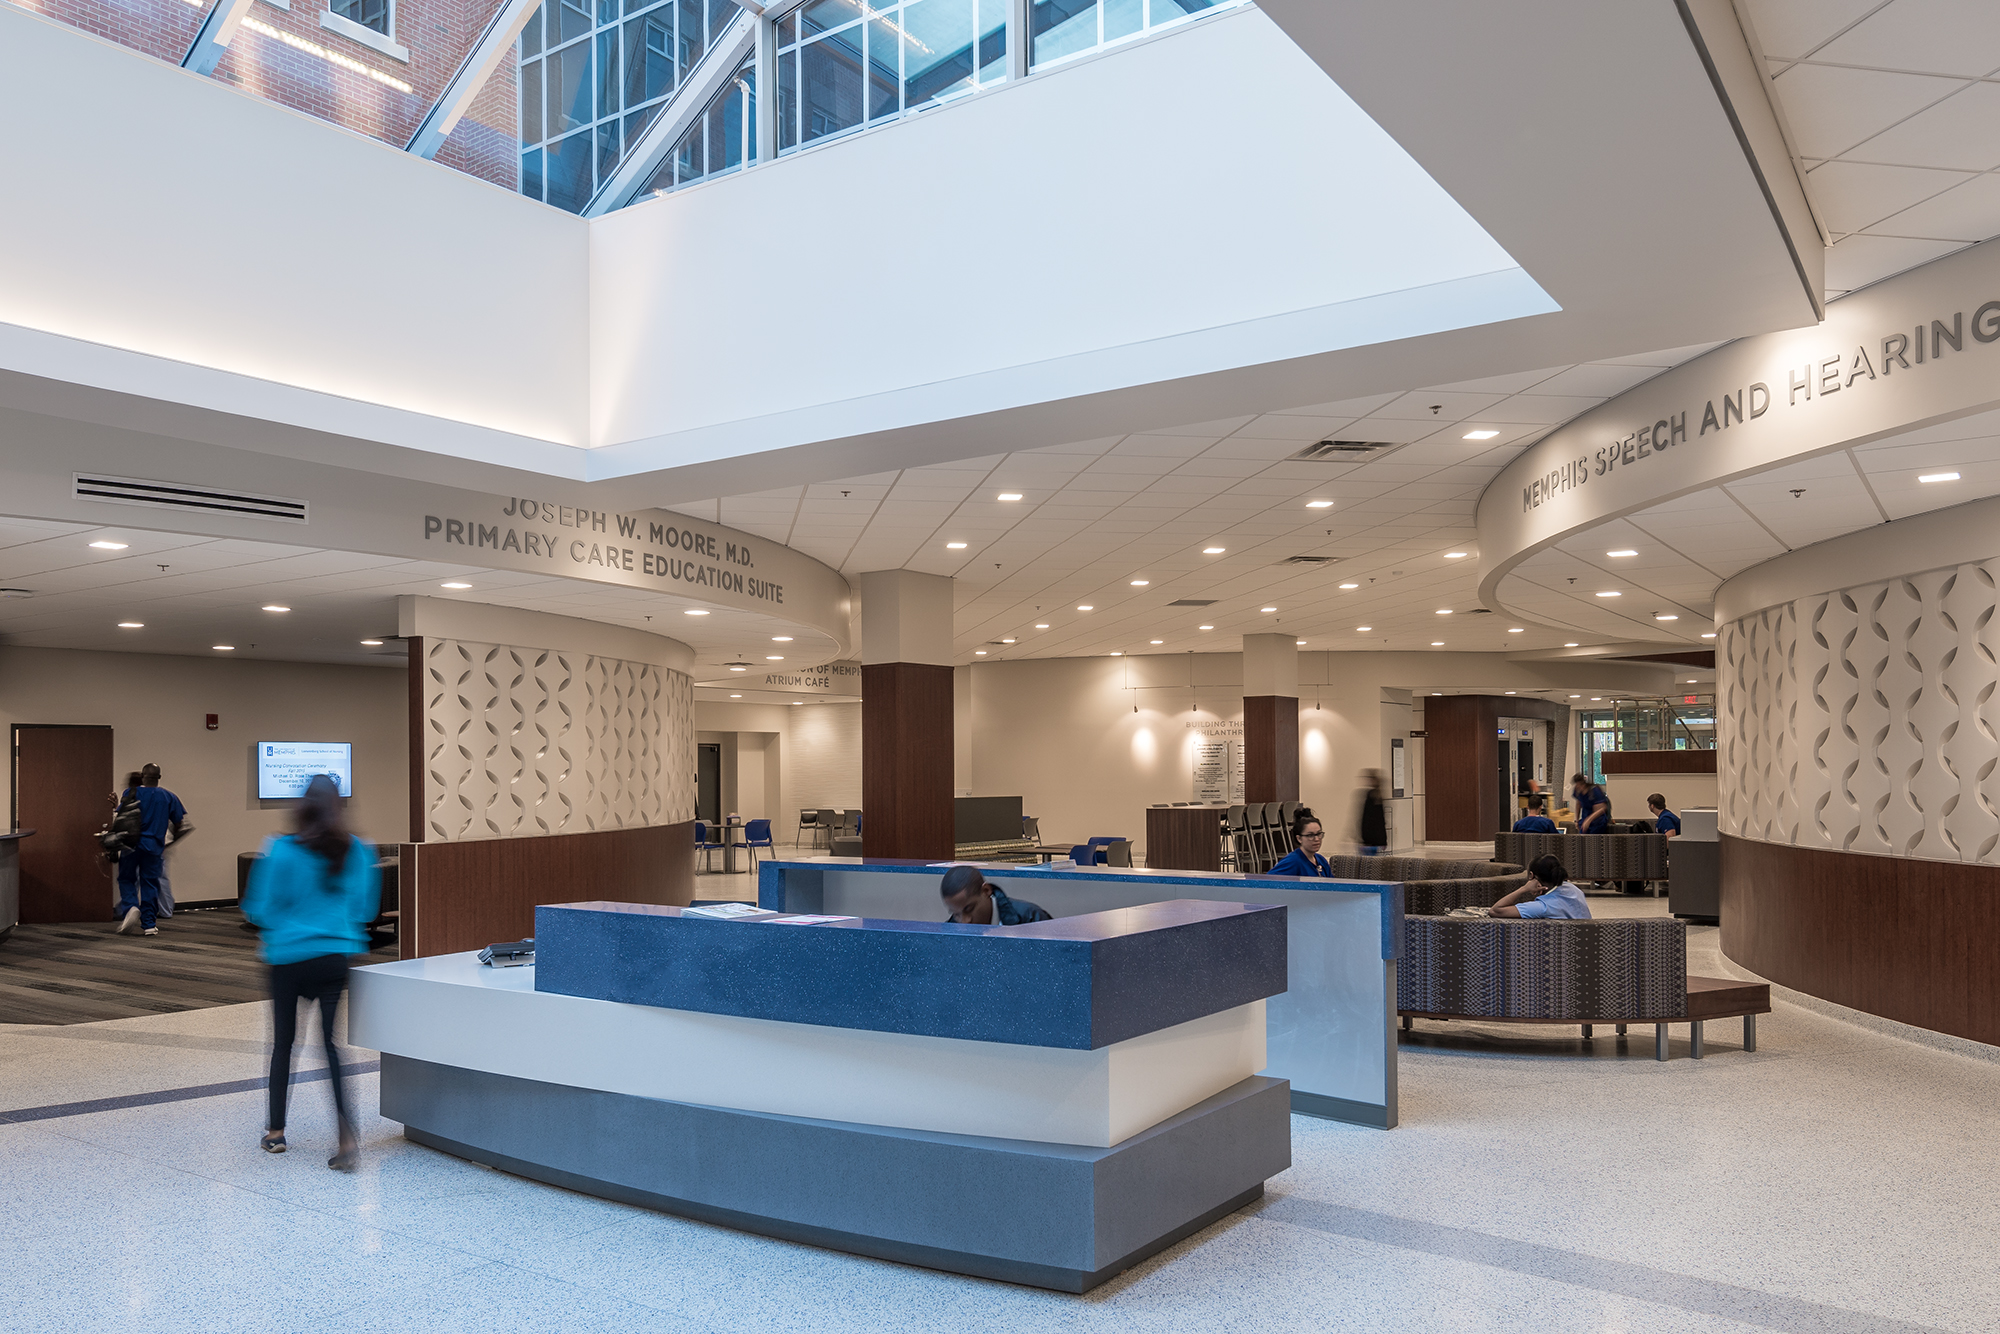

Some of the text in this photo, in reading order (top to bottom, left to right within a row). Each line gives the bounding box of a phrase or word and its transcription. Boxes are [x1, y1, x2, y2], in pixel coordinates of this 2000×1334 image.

[1523, 301, 2000, 513] MEMPHIS SPEECH AND HEARING
[503, 497, 754, 568] JOSEPH W. MOORE, M.D.
[425, 515, 783, 604] PRIMARY CARE EDUCATION SUITE
[765, 675, 829, 688] ATRIUM CAFÉ
[816, 665, 829, 674] OF
[1185, 720, 1226, 728] BUILDING
